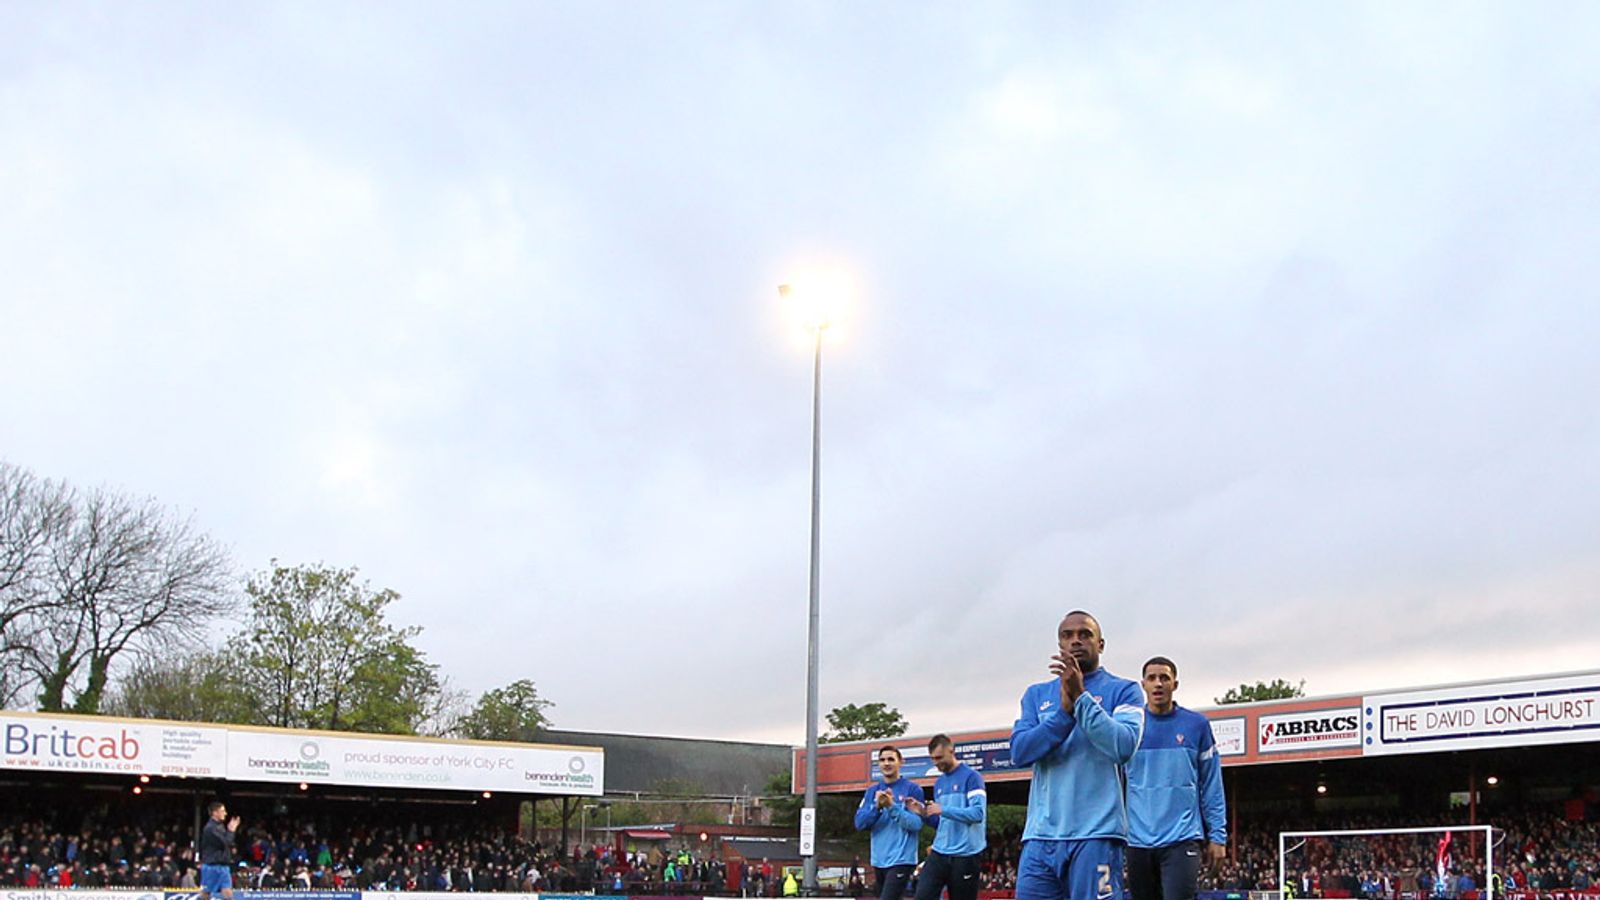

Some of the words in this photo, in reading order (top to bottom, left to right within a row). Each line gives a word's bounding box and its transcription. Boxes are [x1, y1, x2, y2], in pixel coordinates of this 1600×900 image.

[1275, 716, 1358, 736] ABRACS
[1387, 715, 1417, 732] THE
[1427, 709, 1475, 729] DAVID
[1485, 699, 1595, 725] LONGHURST
[6, 724, 139, 760] Britcab
[6, 759, 143, 771] www.ukcabins.com
[344, 752, 381, 763] proud
[383, 755, 428, 766] sponsor
[432, 755, 444, 766] of
[446, 756, 471, 767] York
[473, 758, 496, 770] City
[499, 759, 514, 770] FC
[1097, 864, 1113, 893] 2
